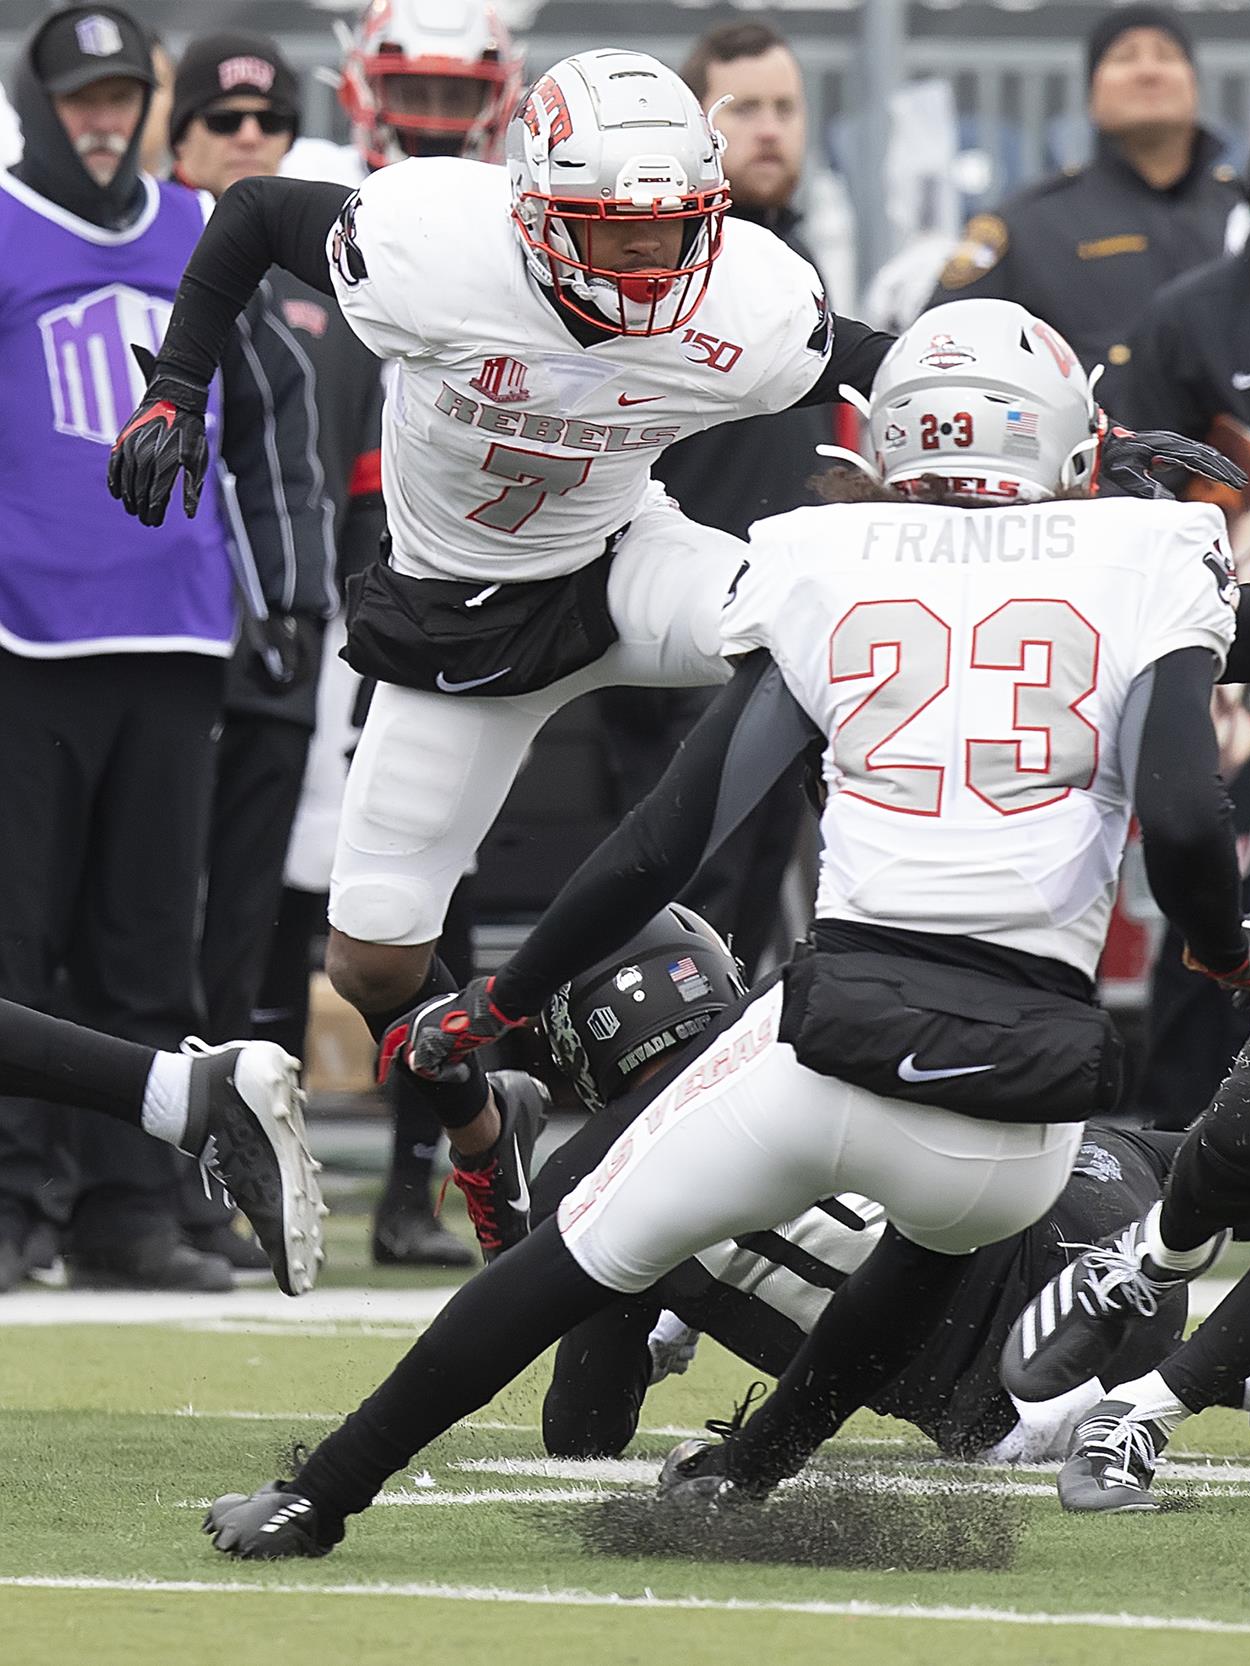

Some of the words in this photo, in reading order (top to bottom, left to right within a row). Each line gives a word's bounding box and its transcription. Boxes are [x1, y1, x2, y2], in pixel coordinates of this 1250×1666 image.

[434, 380, 681, 453] REBELS
[466, 442, 594, 534] 7
[862, 514, 1076, 563] FRANCIS
[830, 598, 1100, 818] 23
[617, 1030, 677, 1075] NEVADA
